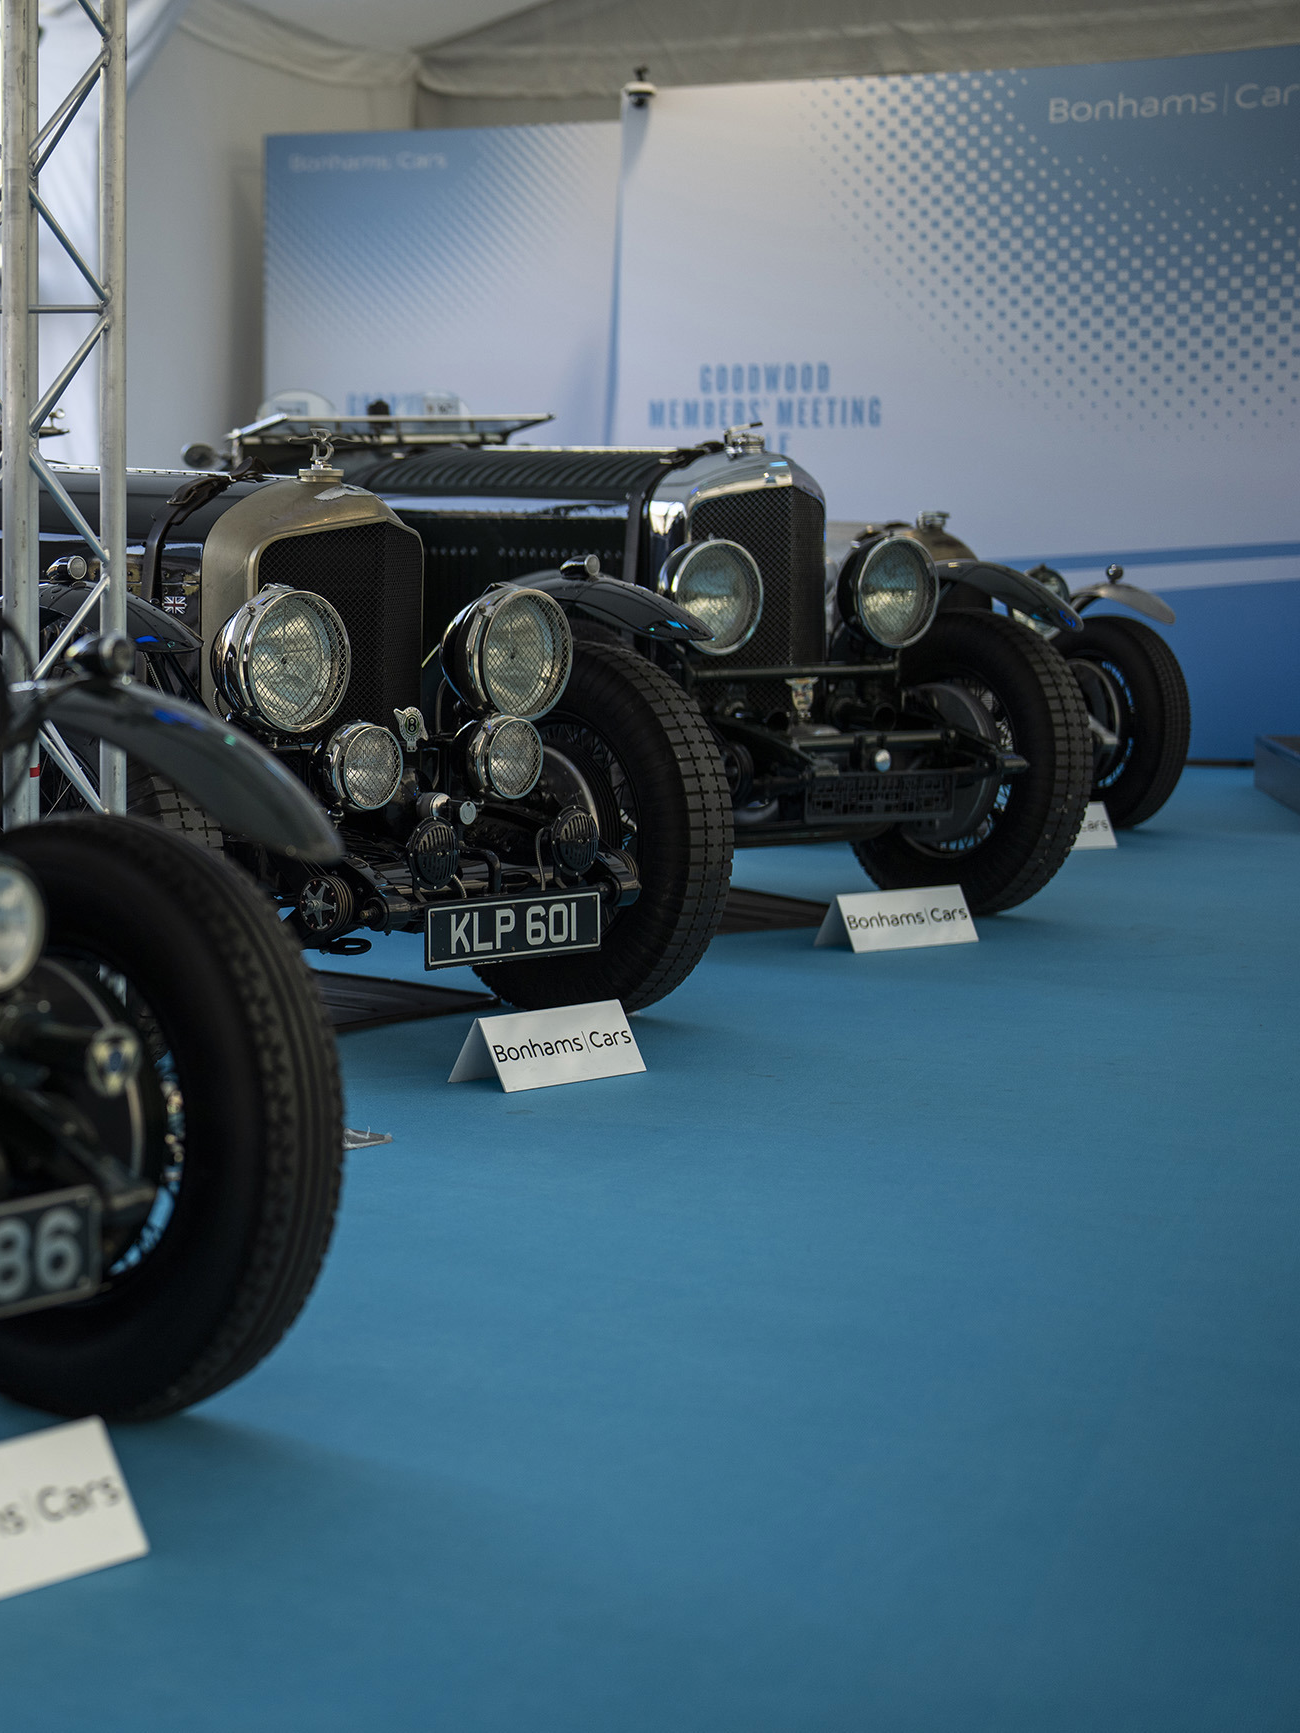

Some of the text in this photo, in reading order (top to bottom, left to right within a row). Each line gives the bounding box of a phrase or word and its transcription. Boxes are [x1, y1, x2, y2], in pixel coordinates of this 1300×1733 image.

[1048, 91, 1217, 124] Bonhams
[700, 361, 830, 394] GOODWOOD
[776, 395, 882, 429] MEETING
[450, 902, 577, 955] KLP 601
[846, 905, 969, 931] Bonhams Cars
[492, 1029, 632, 1063] Bonhams Cars
[36, 1475, 122, 1524] Cars
